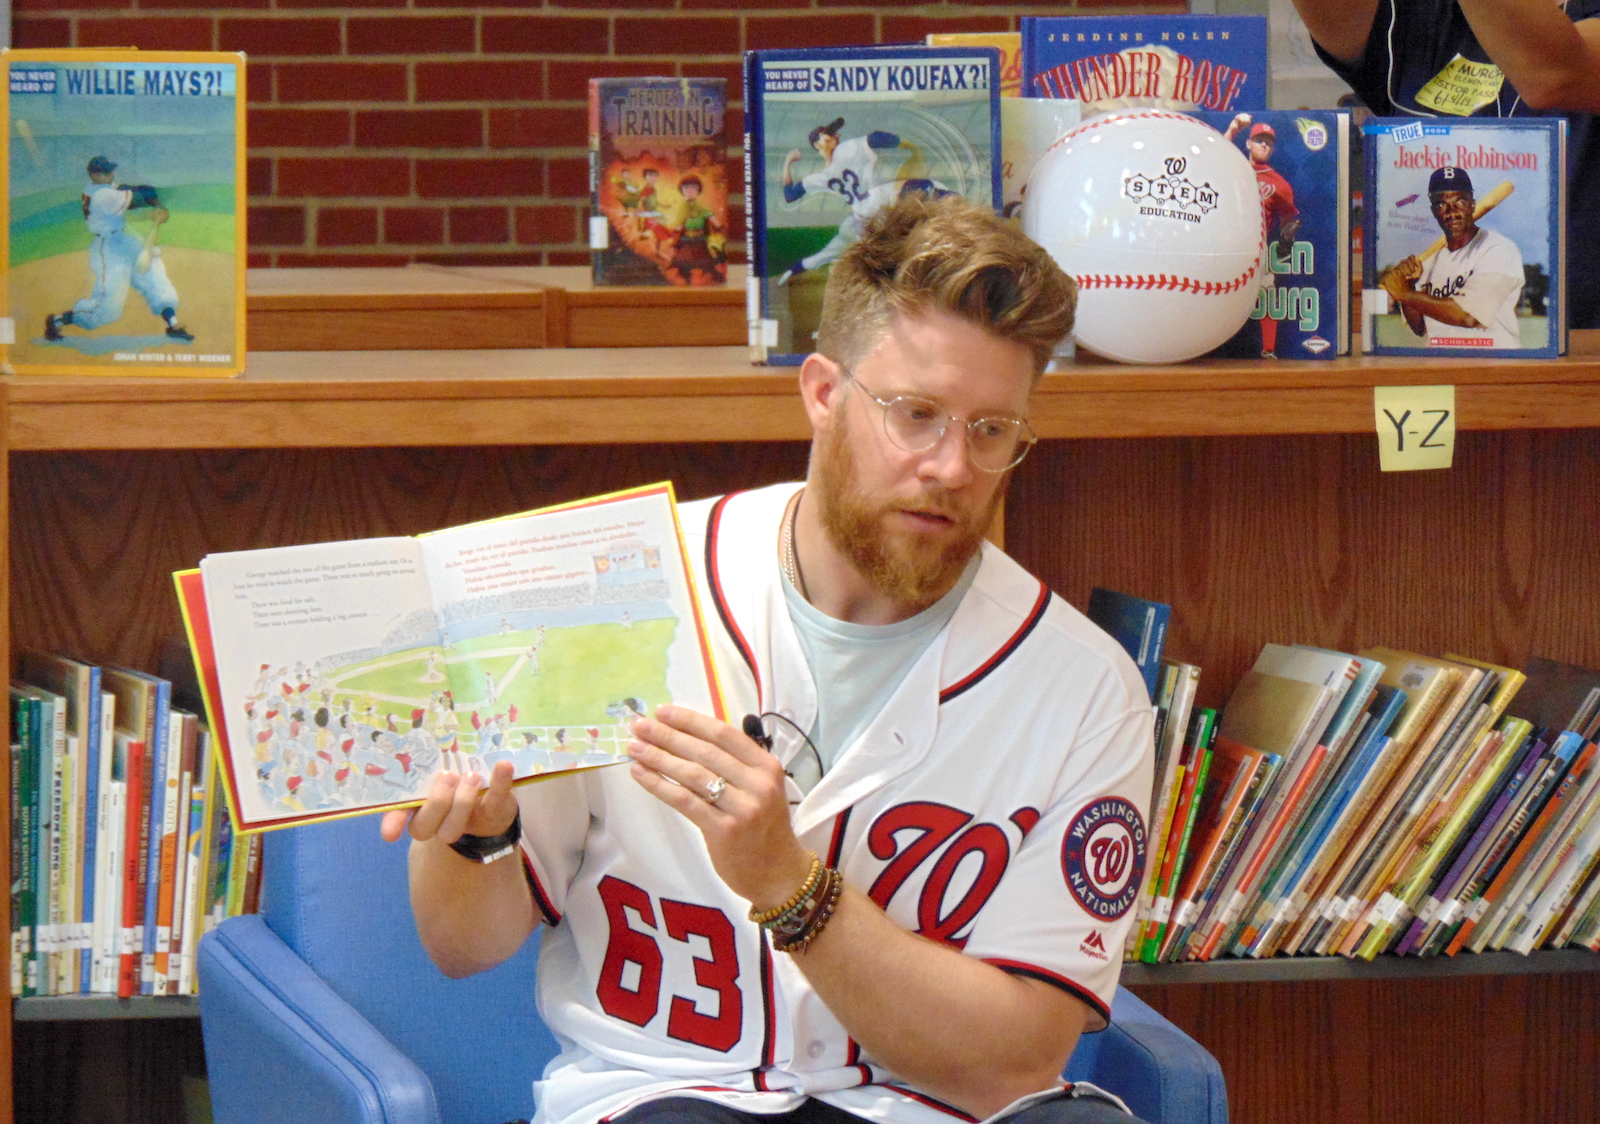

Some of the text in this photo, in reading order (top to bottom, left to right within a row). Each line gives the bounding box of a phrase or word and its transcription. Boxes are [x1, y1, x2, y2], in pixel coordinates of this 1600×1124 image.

[1048, 32, 1231, 42] JERDINE NOLEN
[10, 72, 56, 81] YOU NEVER
[66, 69, 222, 96] WILLIE MAYS?!
[765, 70, 808, 80] YOU NEVER
[813, 66, 880, 92] SANDY
[888, 65, 987, 90] KOUFAX?!
[1032, 52, 1162, 104] THUNDER
[1171, 54, 1248, 111] ROSE
[10, 82, 54, 92] HEARD OF
[765, 81, 808, 90] HEARD OF
[1433, 77, 1495, 98] ISITOR PASS
[612, 97, 714, 136] TRAINING
[1394, 124, 1421, 142] TRUE
[1394, 144, 1538, 170] Jackie Robinson
[1444, 168, 1455, 180] B
[827, 169, 870, 205] 32
[746, 217, 753, 228] OF
[1140, 206, 1202, 223] EDUCATION
[138, 353, 165, 362] WINTER
[167, 354, 172, 362] &
[174, 354, 196, 362] TERRY
[198, 354, 231, 362] WIDENER
[1383, 409, 1450, 452] Y-Z
[51, 770, 62, 870] FREEDOM SONG
[165, 799, 176, 831] SPOTS
[140, 817, 148, 836] NAME
[1073, 802, 1144, 856] WASHINGTON
[164, 836, 173, 848] IN
[137, 849, 146, 883] BLESSING
[162, 864, 172, 883] BOX
[1071, 872, 1135, 916] NATIONALS
[1080, 944, 1109, 962] Majestic
[597, 874, 743, 1053] 63
